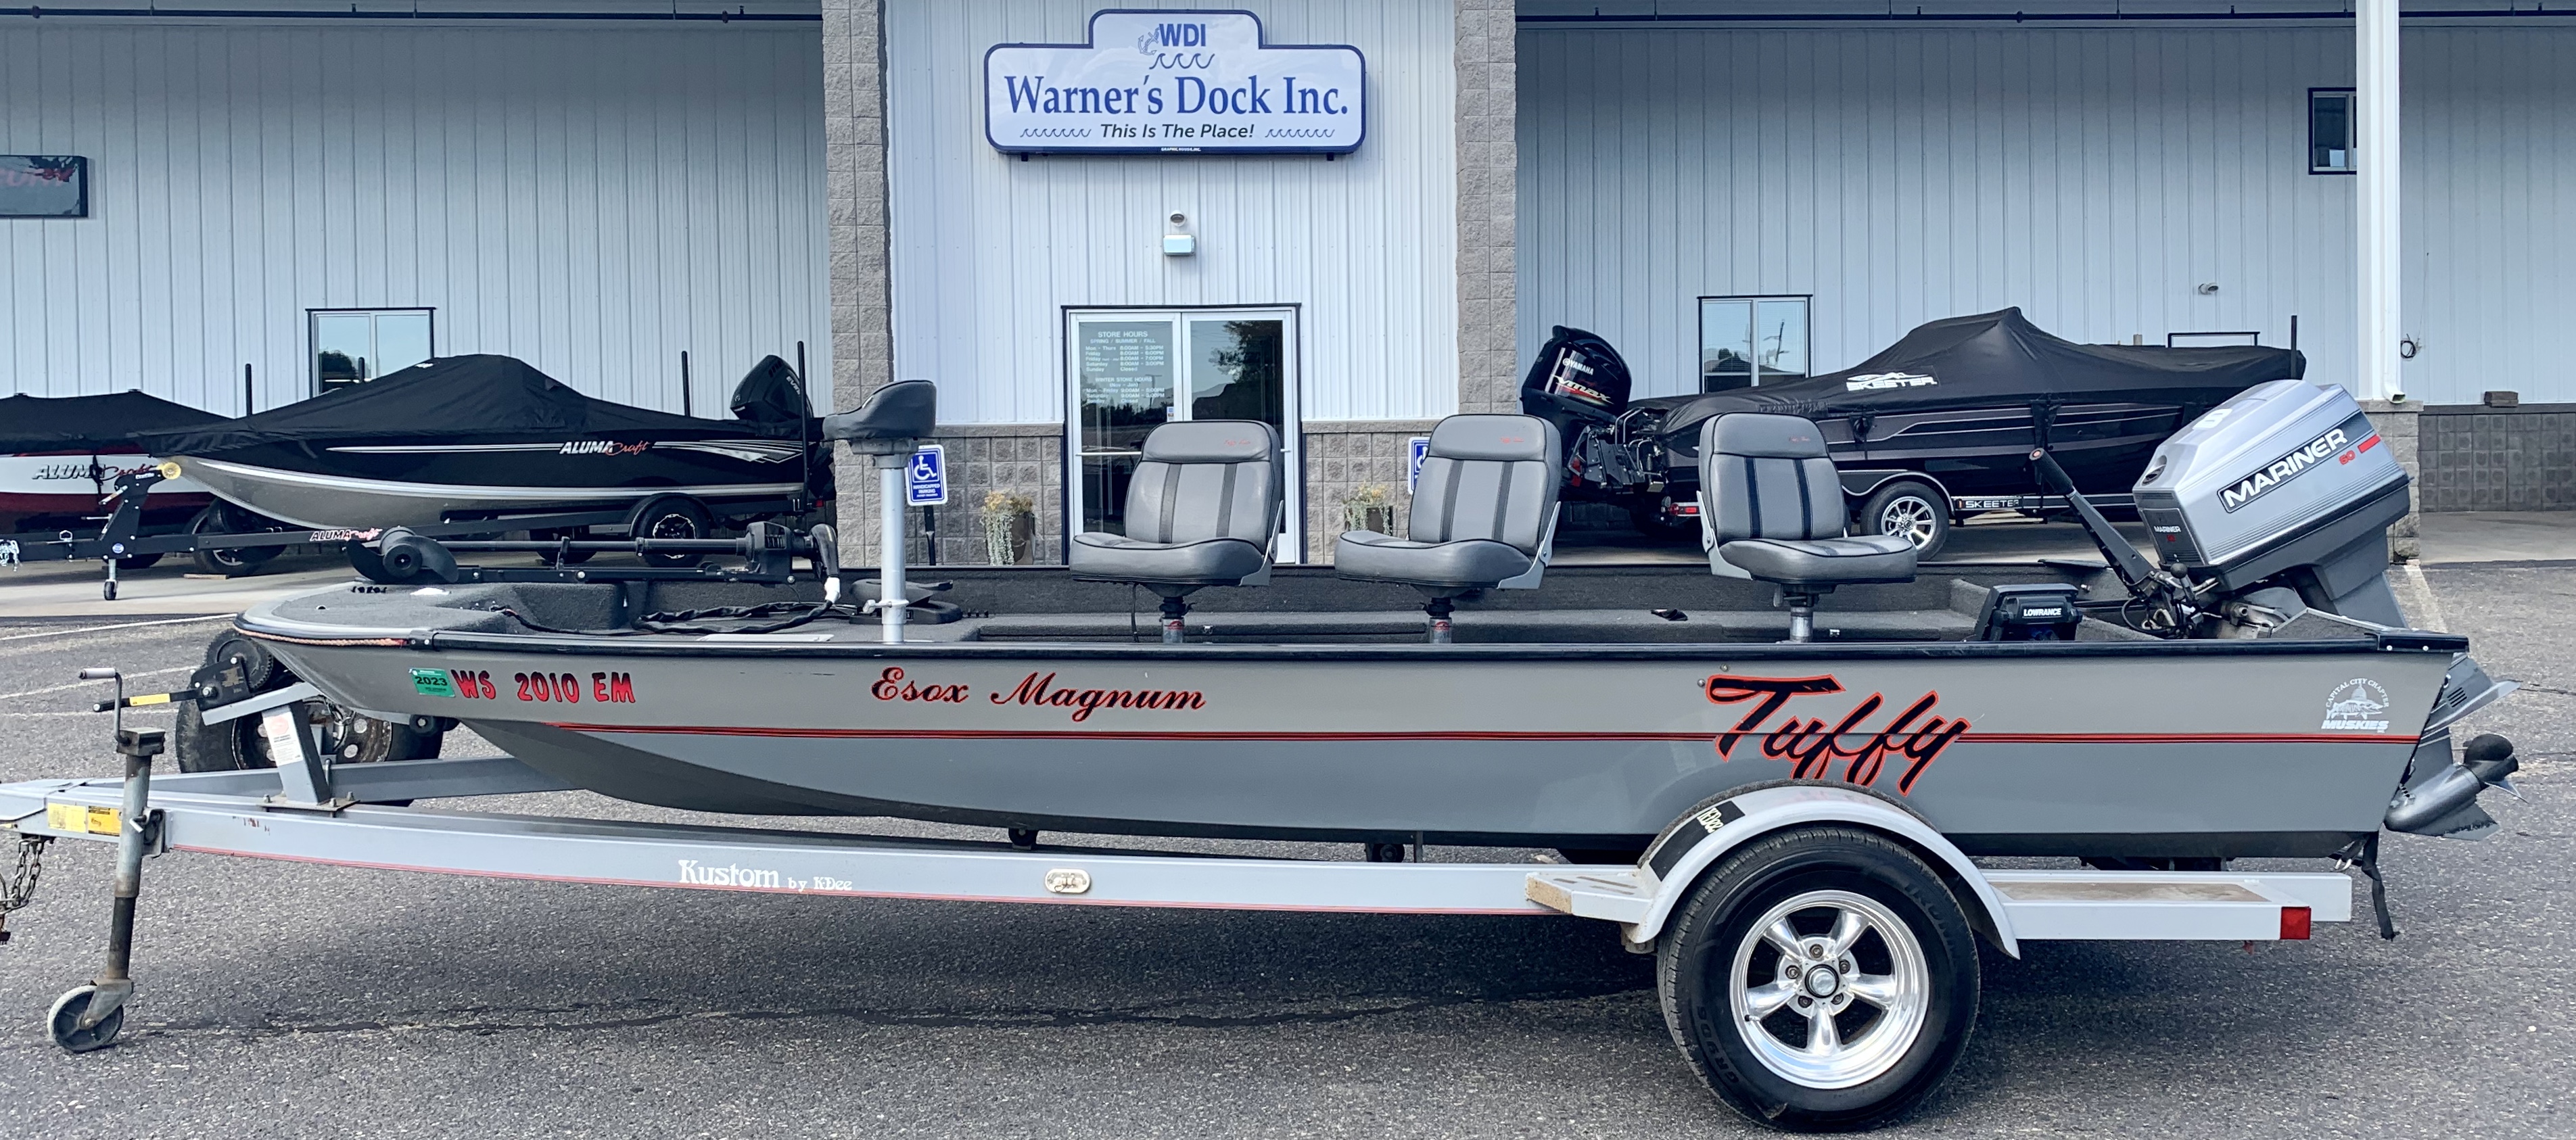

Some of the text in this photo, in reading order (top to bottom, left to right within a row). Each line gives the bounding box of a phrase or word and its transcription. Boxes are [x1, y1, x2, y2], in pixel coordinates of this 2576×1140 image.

[1158, 23, 1207, 47] WDI
[1004, 75, 1349, 115] Warner's Dock Inc.
[1100, 124, 1255, 138] This Is The Place!
[1570, 359, 1594, 376] YAMAHA
[1846, 376, 1938, 391] SKEETER
[2223, 428, 2348, 508] MARINER
[1965, 499, 2019, 508] SKEETER
[2153, 525, 2182, 533] MARINER
[2023, 607, 2062, 617] LOWRANCE
[415, 675, 448, 686] 2023
[450, 669, 636, 704] WS 2010 EM
[871, 666, 1207, 722] Esox Magnum
[2325, 678, 2390, 708] CAPITAL CITY CHAPTER
[2320, 719, 2389, 730] MUSKIES
[1705, 673, 1973, 798] Tuffy
[678, 859, 780, 888] Kustom
[787, 877, 808, 893] by
